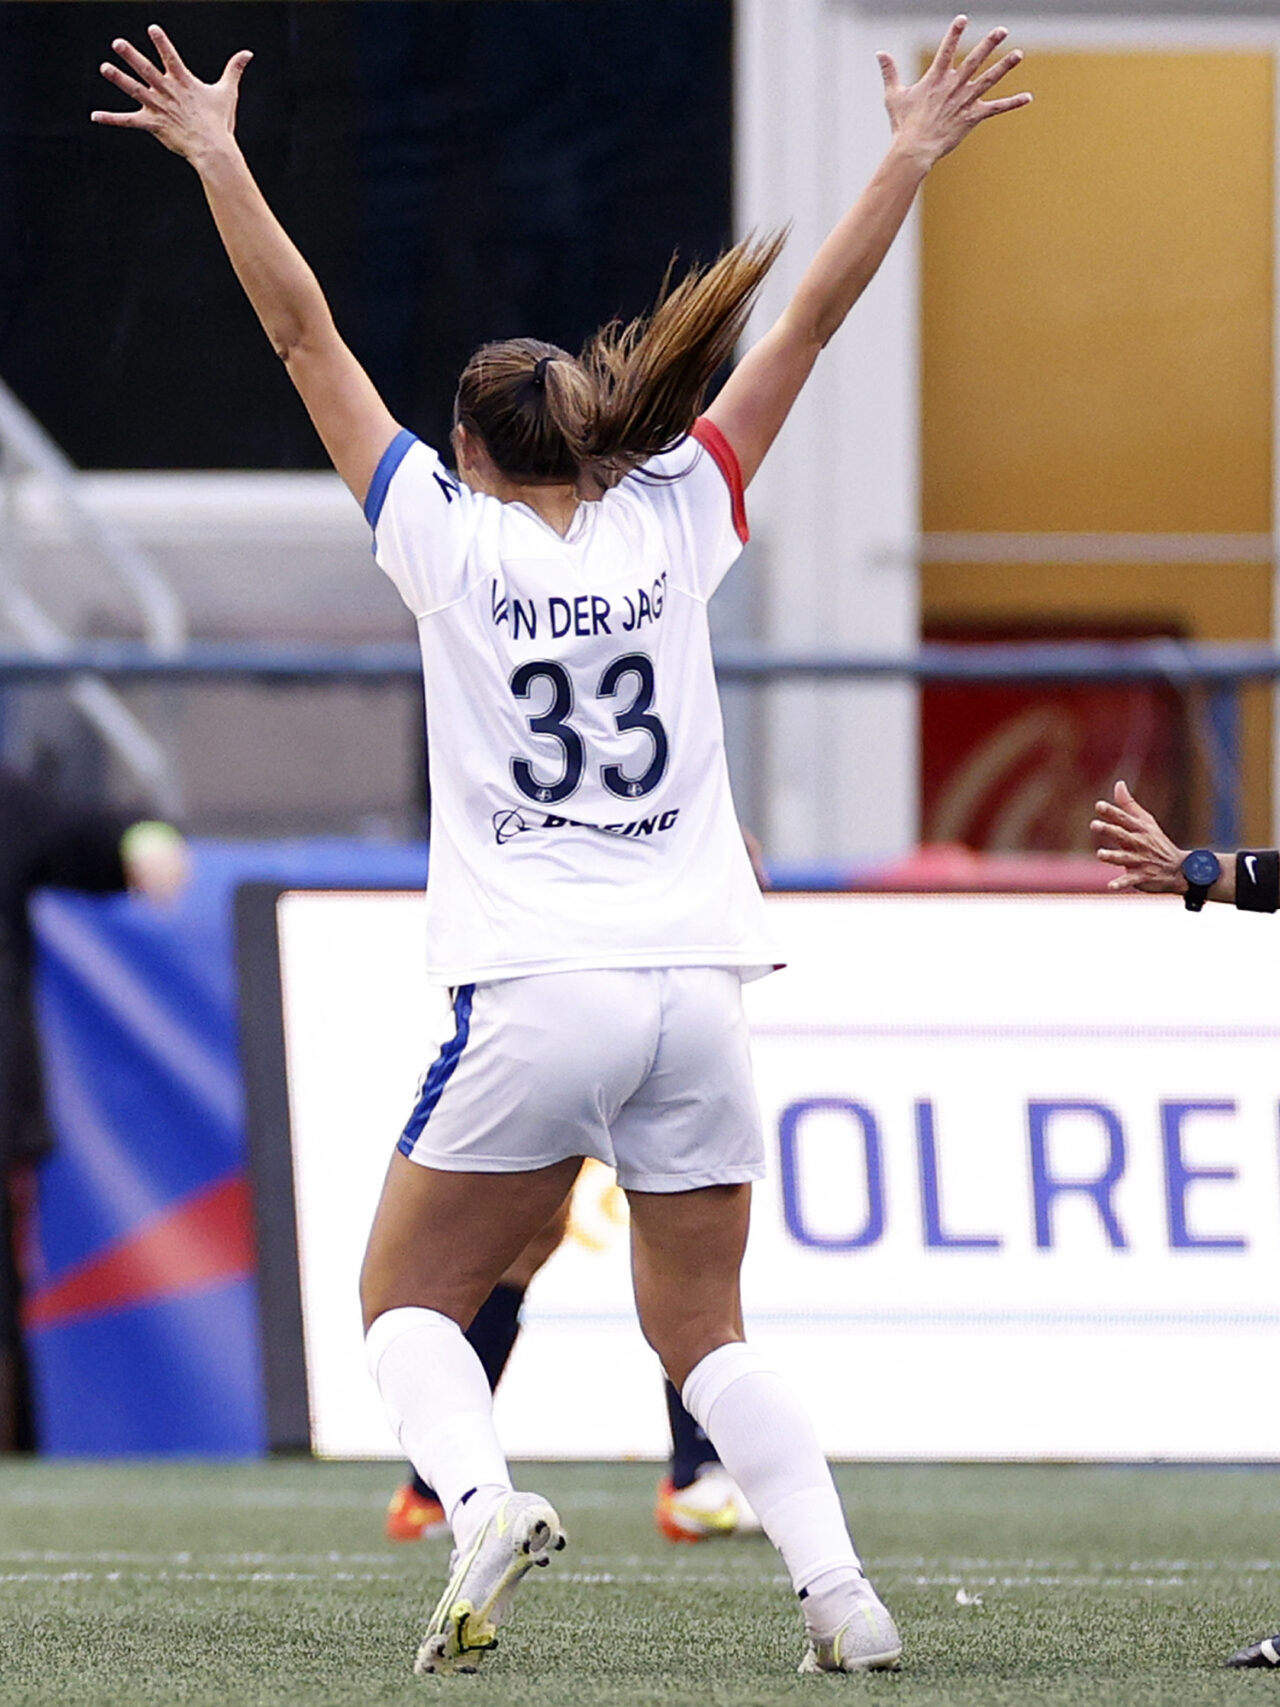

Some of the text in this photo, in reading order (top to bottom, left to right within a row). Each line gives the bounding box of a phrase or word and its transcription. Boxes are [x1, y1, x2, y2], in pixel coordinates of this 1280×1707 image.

[548, 595, 612, 639] DER
[508, 651, 670, 806] 33
[778, 1095, 1280, 1253] OLRE
